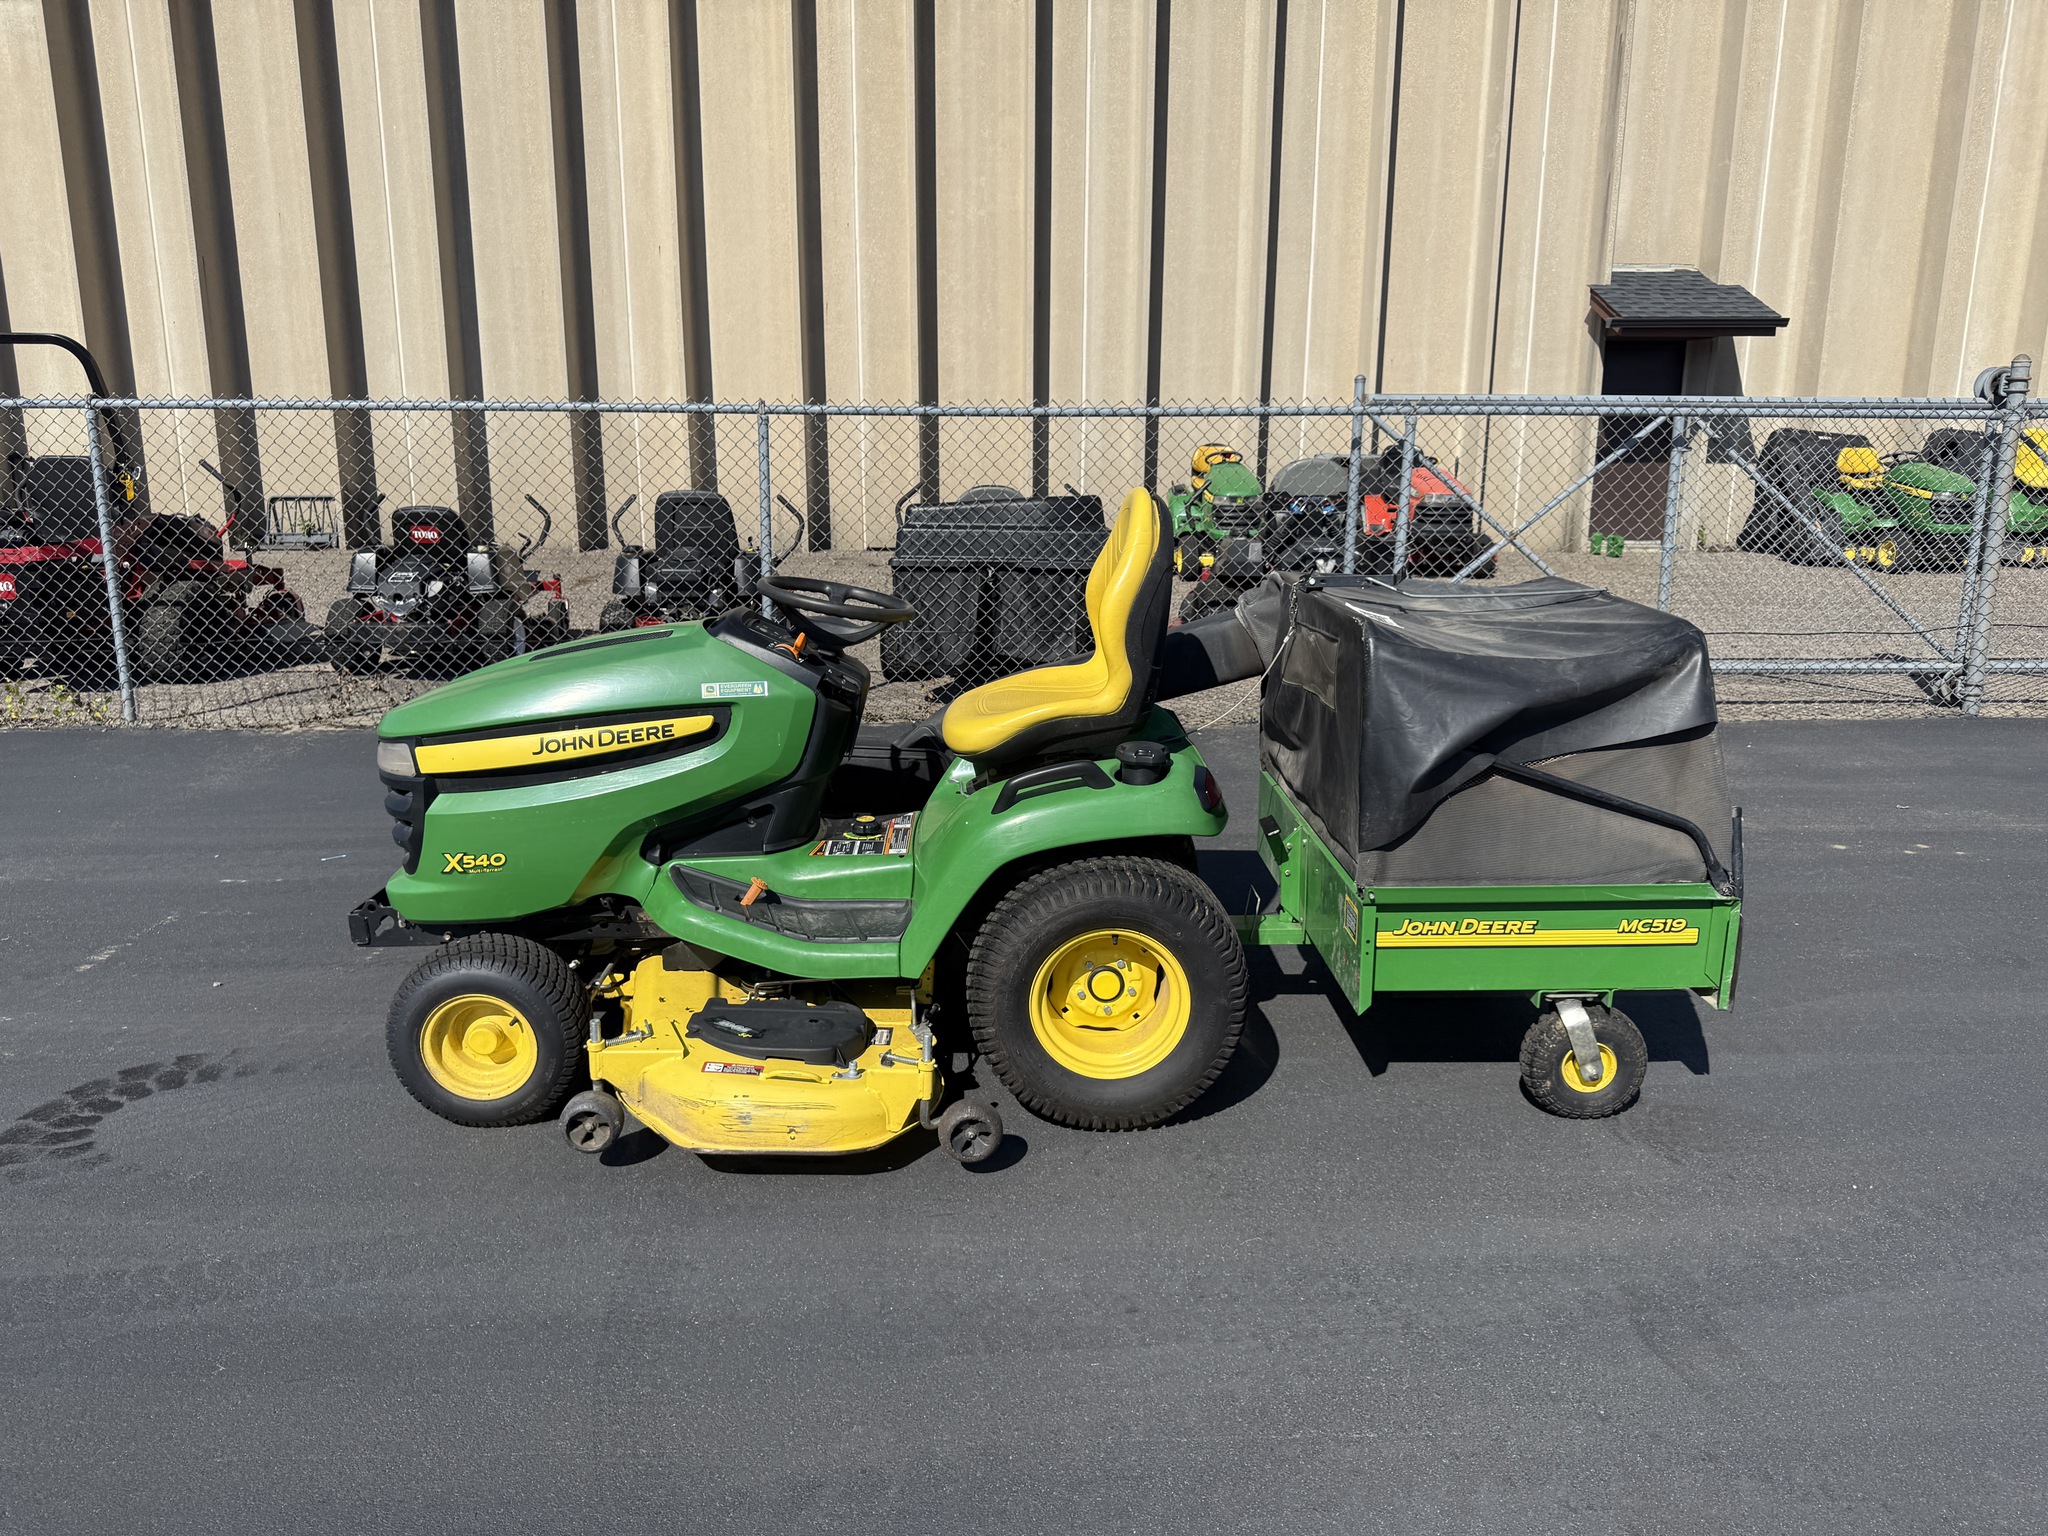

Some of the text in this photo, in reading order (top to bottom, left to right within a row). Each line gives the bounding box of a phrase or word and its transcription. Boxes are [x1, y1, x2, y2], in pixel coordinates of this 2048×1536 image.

[412, 530, 438, 539] TORO
[532, 723, 675, 756] JOHN DEERE
[442, 853, 506, 873] X540
[1393, 918, 1539, 936] JOHN DEERE
[1618, 918, 1688, 934] MC519
